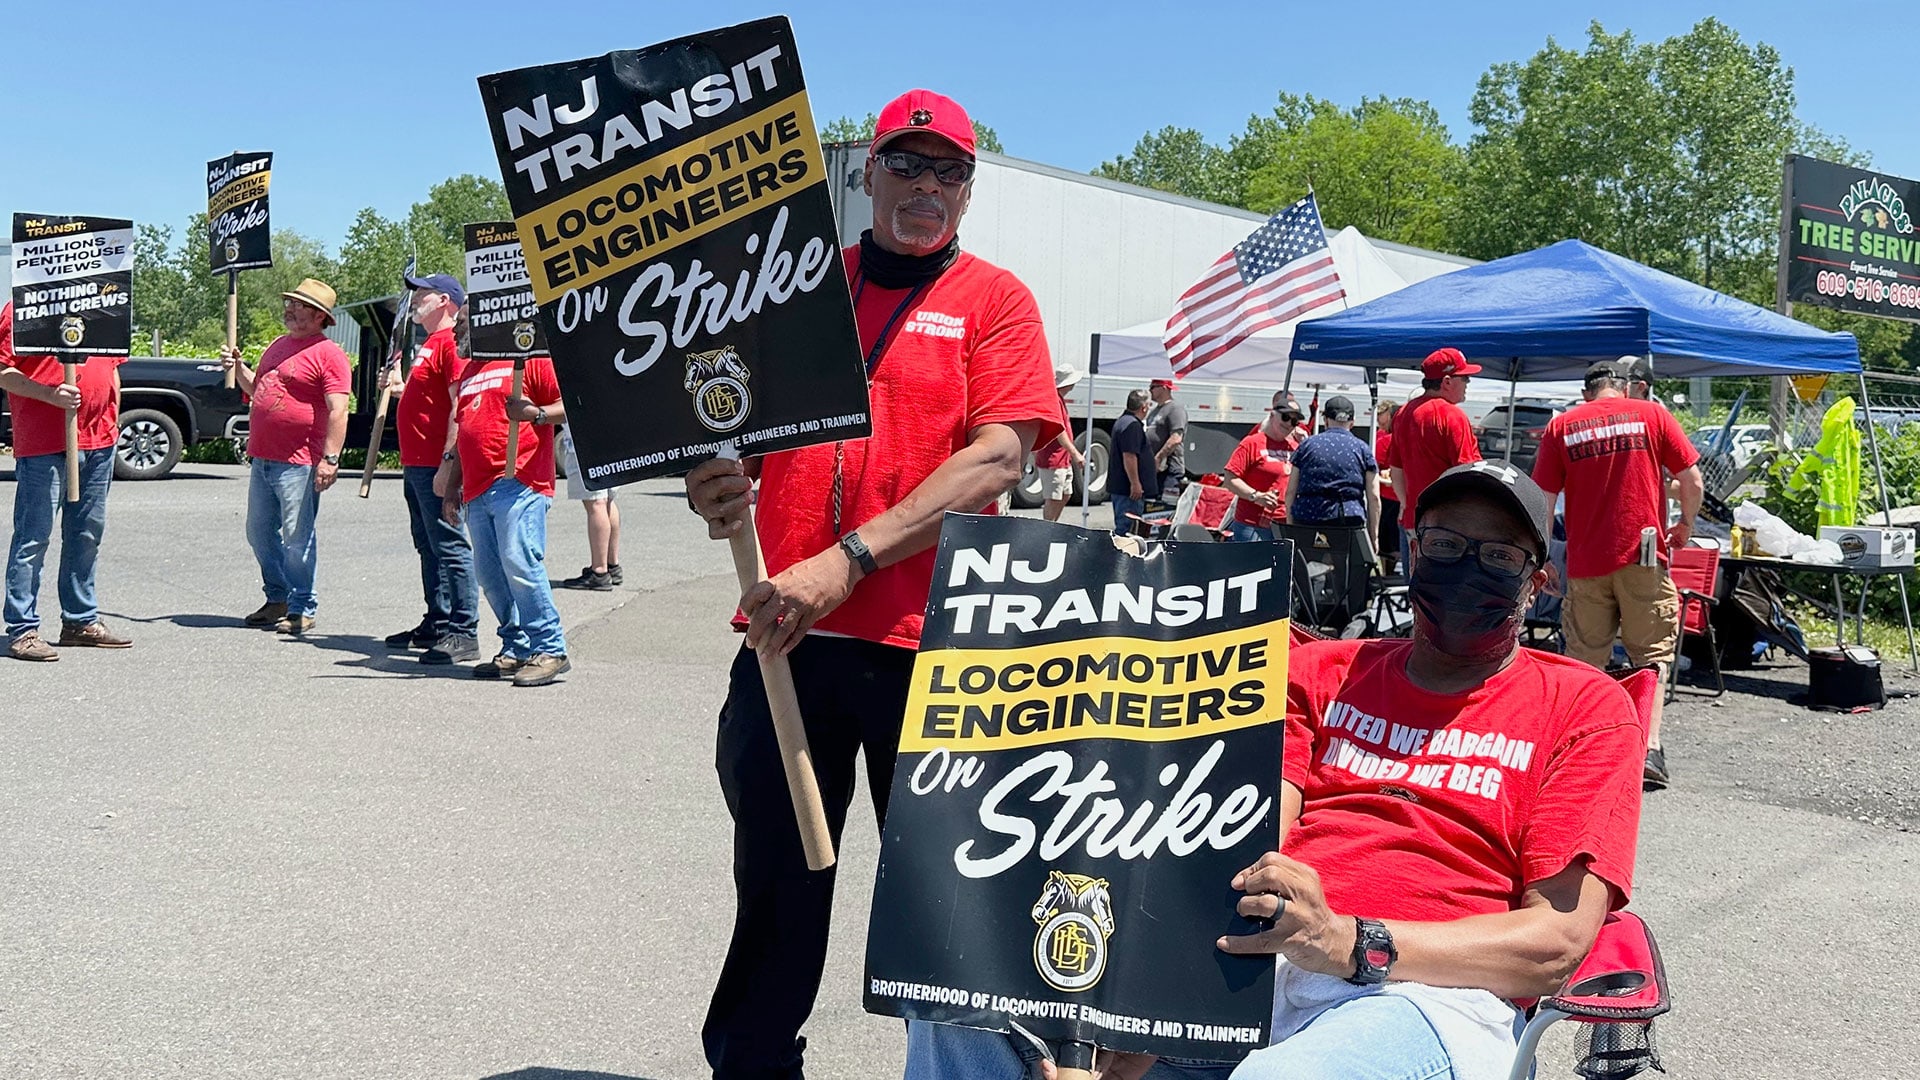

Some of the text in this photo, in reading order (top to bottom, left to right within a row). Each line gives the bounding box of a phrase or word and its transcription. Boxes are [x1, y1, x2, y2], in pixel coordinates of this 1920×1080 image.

[502, 75, 600, 151] NJ
[514, 44, 782, 195] TRANSIT
[209, 161, 227, 182] NJ
[209, 158, 269, 194] TRANSIT
[533, 110, 800, 252] LOCOMOTIVE
[210, 175, 266, 208] LOCOMOTIVE
[210, 185, 265, 220] ENGINEERS
[25, 219, 46, 228] NJ
[216, 200, 268, 246] Strike
[476, 226, 495, 237] NJ
[543, 149, 808, 291] ENGINEERS
[23, 237, 106, 256] MILLIONS
[477, 231, 519, 245] TRANS
[1799, 218, 1920, 265] TREE SERVI
[16, 245, 125, 269] PENTHOUSE
[44, 260, 102, 276] VIEWS
[470, 260, 525, 276] PENTH
[15, 292, 129, 321] TRAIN CREWS
[24, 282, 98, 305] NOTHING
[479, 291, 536, 312] NOTHIN
[556, 205, 834, 377] On Strike
[471, 308, 518, 328] TRAIN
[916, 311, 965, 327] UNION
[1564, 421, 1646, 447] MOVE WITHOUT
[1566, 416, 1605, 433] TRAINS
[588, 412, 867, 480] BROTHERHOOD OF LOCOMOTIVE ENGINEERS AND TRAINMEN
[947, 542, 1069, 588] NJ
[944, 567, 1273, 635] TRANSIT
[928, 638, 1269, 695] LOCOMOTIVE
[920, 679, 1266, 739] ENGINEERS
[1323, 700, 1535, 772] NITED WE BARGAIN
[1408, 764, 1451, 789] WE
[1448, 763, 1502, 800] BEG
[910, 740, 1272, 879] On Strike
[871, 978, 1261, 1043] BROTHERHOOD OF LOCOMOTIVE ENGINEERS AND TRAINMEN
